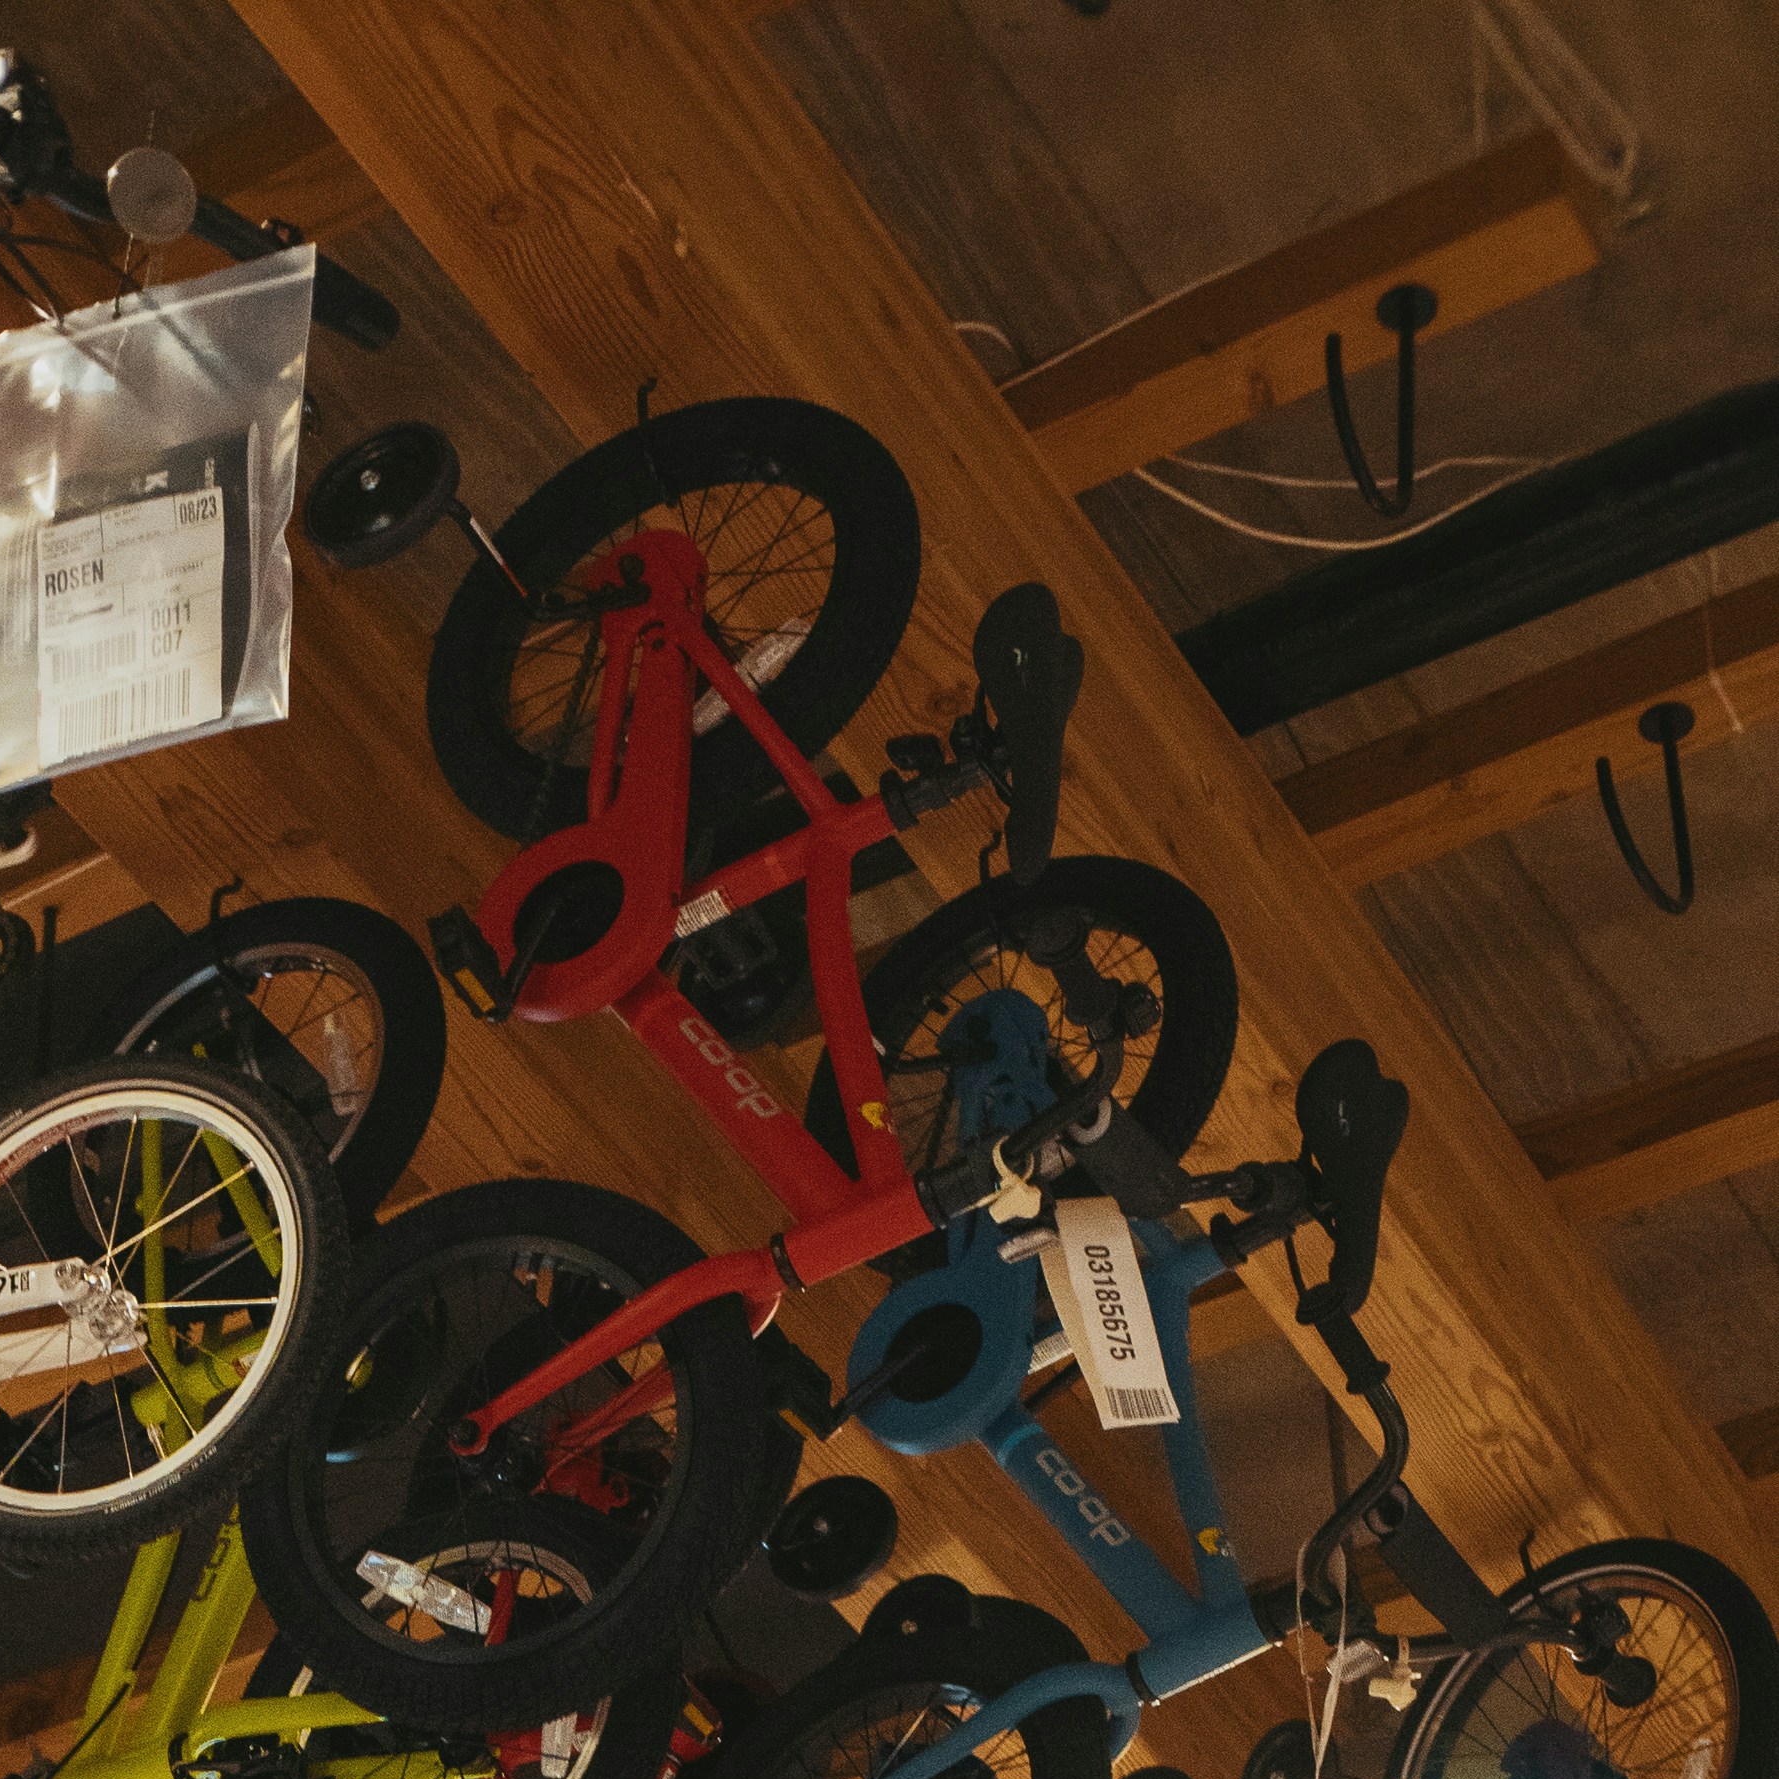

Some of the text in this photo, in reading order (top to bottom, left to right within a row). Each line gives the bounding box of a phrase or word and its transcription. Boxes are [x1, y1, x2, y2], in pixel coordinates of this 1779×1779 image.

[178, 495, 218, 525] 08/23
[44, 558, 105, 598] ROSEN
[151, 598, 192, 631] 0011
[1083, 1244, 1137, 1361] 03185675
